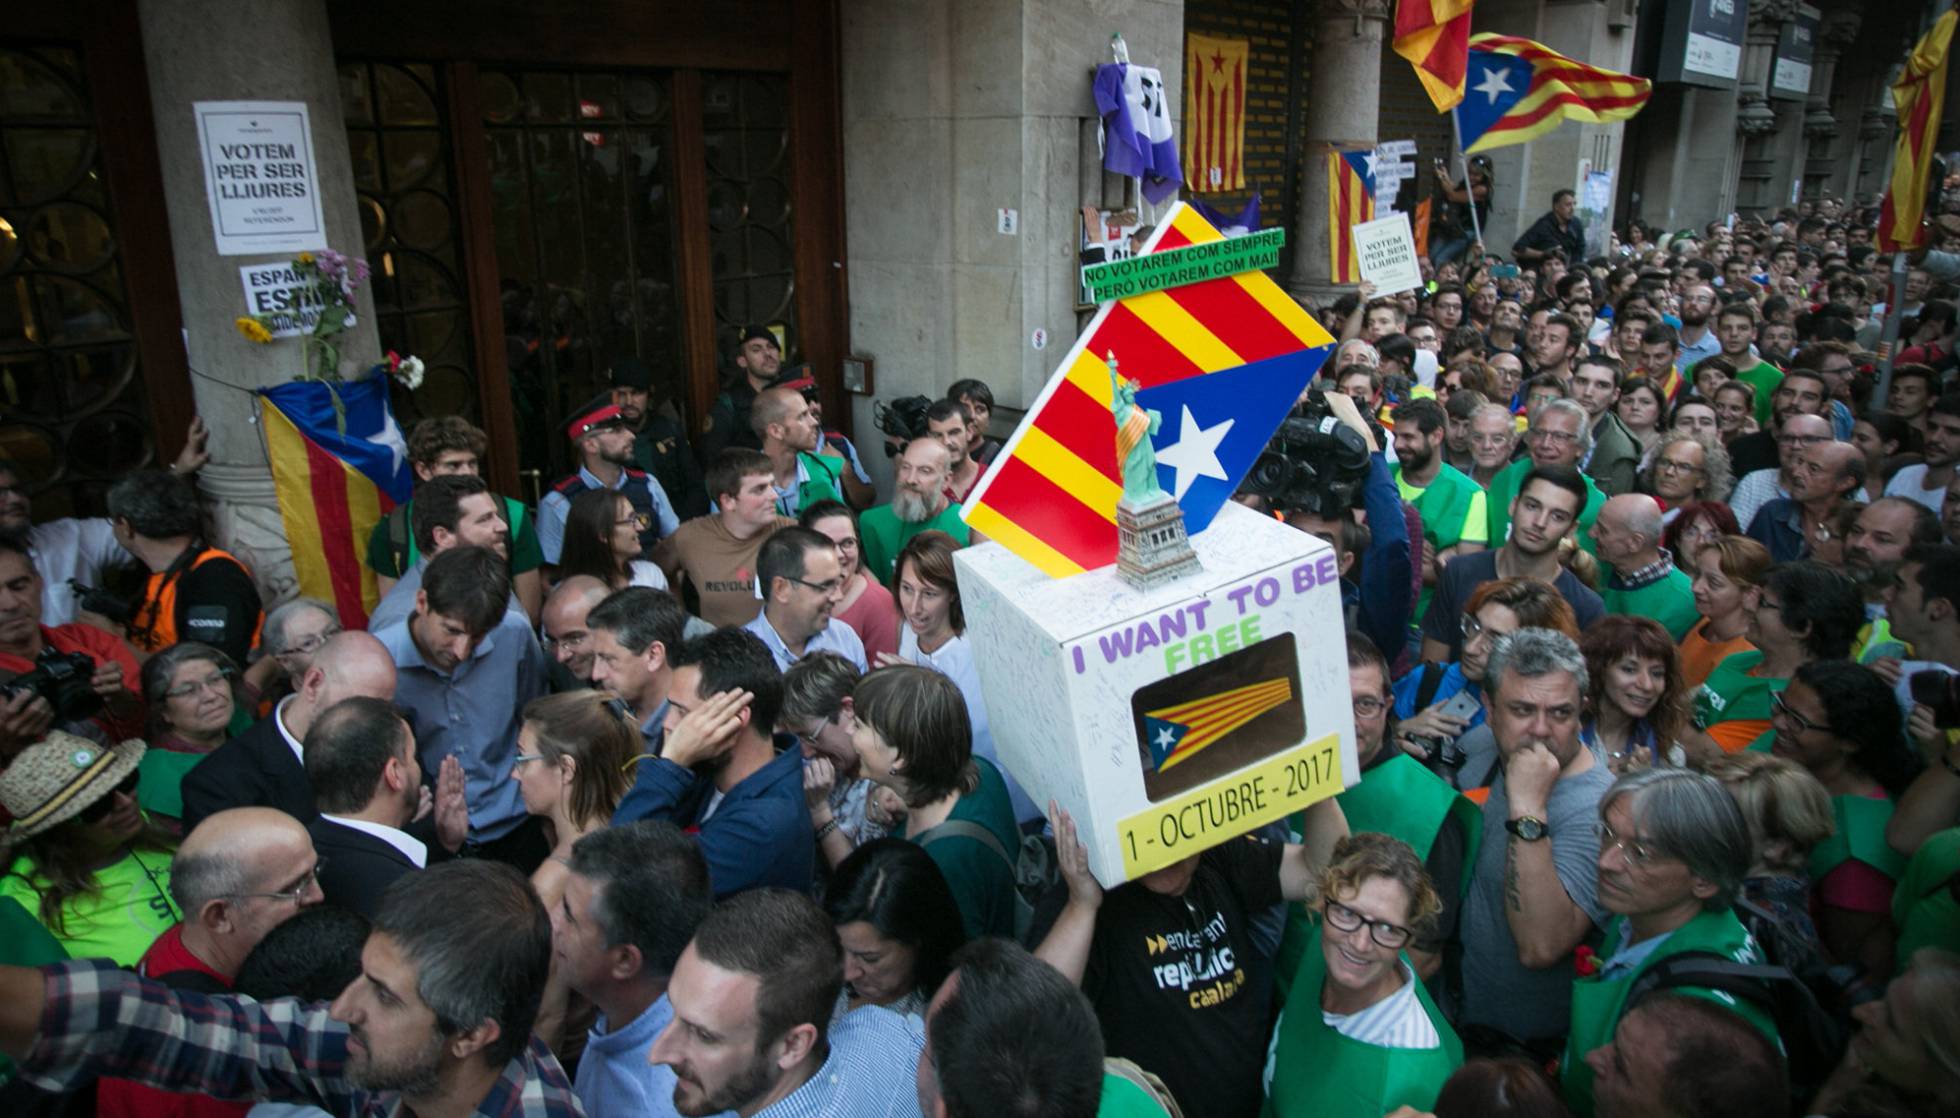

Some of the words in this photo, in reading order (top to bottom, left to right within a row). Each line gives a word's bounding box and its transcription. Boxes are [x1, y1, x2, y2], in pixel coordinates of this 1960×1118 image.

[220, 143, 296, 160] VOTEM
[216, 163, 258, 180] PER
[263, 162, 306, 179] SER
[220, 182, 307, 199] LLIURES
[1366, 235, 1403, 251] VOTEM
[1084, 269, 1106, 283] NO
[1110, 252, 1182, 276] VOTAREM
[1187, 245, 1220, 262] COM
[1223, 234, 1285, 254] SEMPRE,
[1364, 251, 1385, 263] PER
[249, 268, 308, 288] ESPAN
[1094, 280, 1135, 300] PERÒ
[1139, 265, 1209, 288] VOTAREM
[1213, 258, 1245, 271] COM
[1249, 253, 1279, 268] MAI!
[1072, 645, 1085, 674] I
[1098, 600, 1211, 663] WANT
[1227, 577, 1281, 615] TO
[1292, 554, 1338, 594] BE
[1164, 614, 1263, 676] FREE
[1126, 830, 1138, 861] 1
[1160, 776, 1267, 848] OCTUBRE
[1284, 748, 1334, 798] 2017
